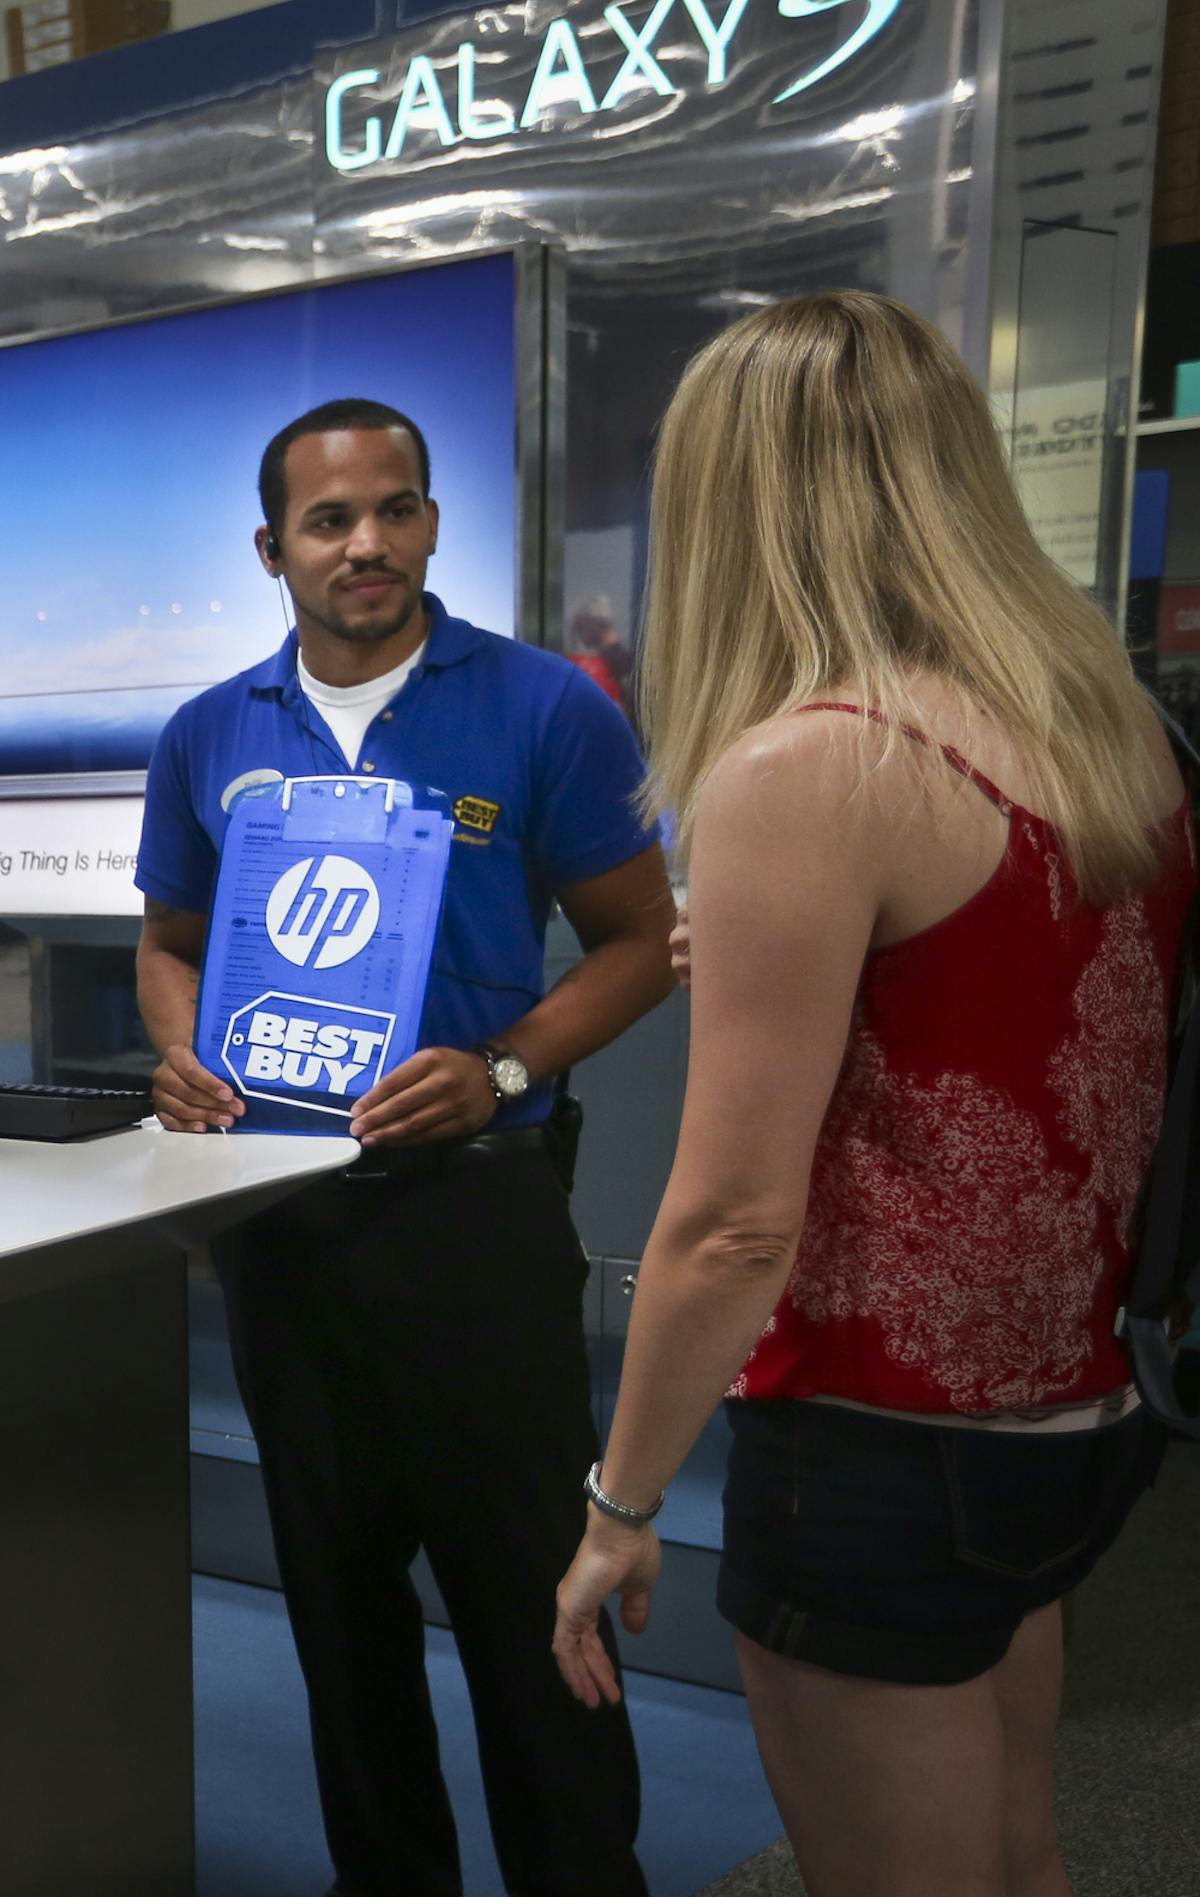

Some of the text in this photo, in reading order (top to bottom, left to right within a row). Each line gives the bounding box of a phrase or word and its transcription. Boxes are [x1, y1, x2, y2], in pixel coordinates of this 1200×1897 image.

[325, 0, 747, 170] GALAXY
[460, 810, 490, 828] BUY
[462, 800, 497, 818] BEST
[19, 850, 68, 876] Thing
[74, 850, 90, 870] Is
[96, 850, 137, 870] Here
[277, 860, 370, 968] hp
[247, 1010, 385, 1065] BEST
[244, 1044, 367, 1095] BUY
